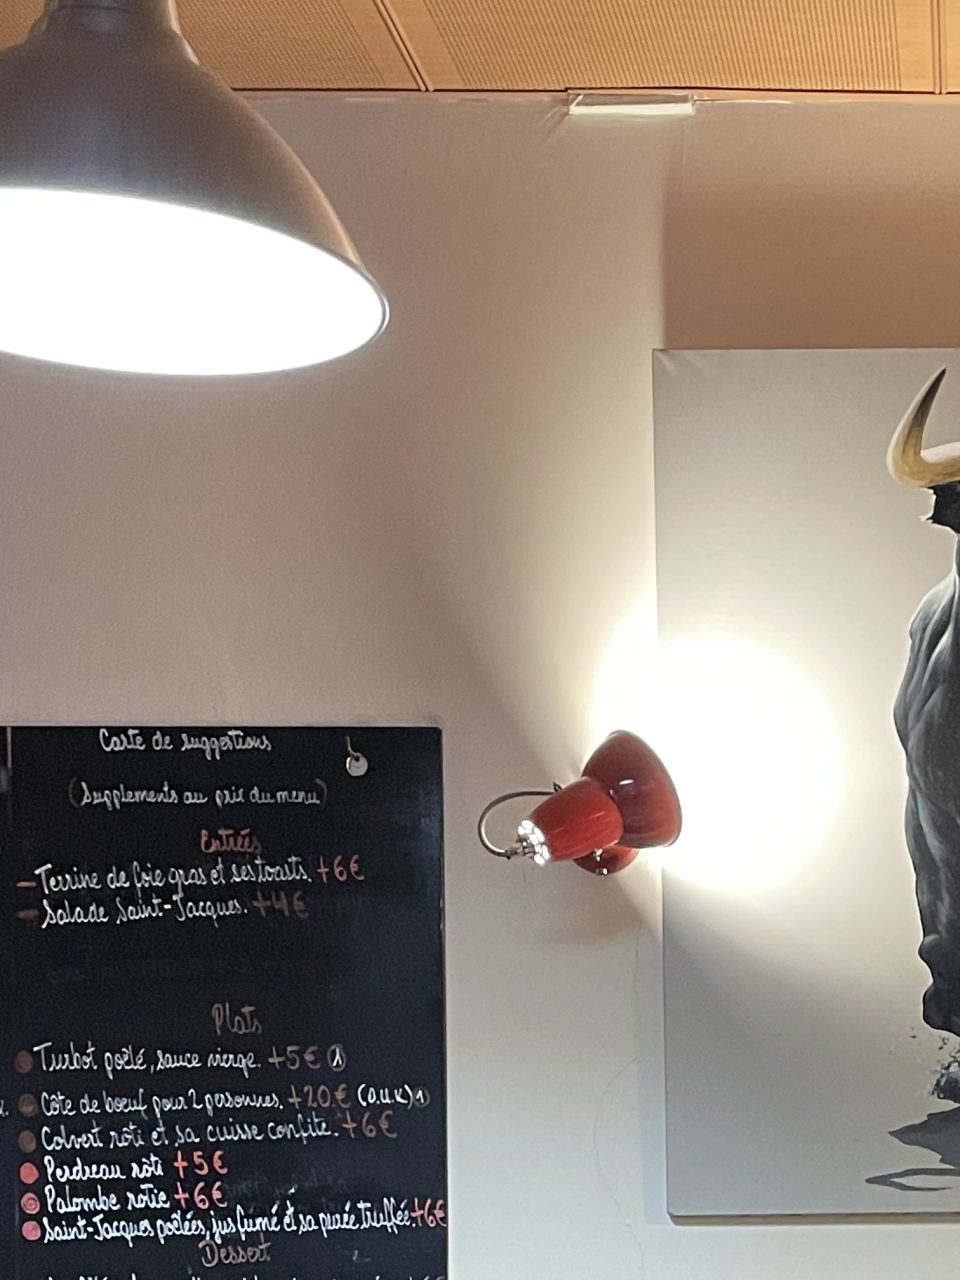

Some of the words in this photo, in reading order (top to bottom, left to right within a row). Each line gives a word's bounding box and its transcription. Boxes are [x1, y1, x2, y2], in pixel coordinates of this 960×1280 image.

[99, 728, 146, 751] Carte
[152, 731, 173, 750] de
[181, 729, 272, 760] suggestions
[183, 789, 208, 804] au
[250, 786, 275, 804] du
[34, 863, 101, 894] Terrine
[107, 865, 129, 888] de
[134, 861, 166, 899] foie
[168, 867, 207, 895] gras
[211, 857, 225, 885] et
[41, 899, 109, 929] Salade
[212, 1003, 262, 1035] Plats
[33, 1041, 97, 1071] Turbot
[157, 1049, 201, 1071] sauce
[41, 1091, 76, 1116] Côte
[80, 1093, 101, 1114] de
[152, 1094, 187, 1121] pour
[188, 1088, 203, 1109] 2
[41, 1120, 103, 1150] Colvert
[151, 1119, 168, 1146] et
[175, 1124, 200, 1147] sa
[207, 1118, 264, 1142] cuisse
[44, 1155, 126, 1183] Perdreau
[44, 1184, 121, 1213] Palombe
[210, 1210, 236, 1245] jus
[236, 1202, 280, 1241] fumé
[283, 1200, 297, 1232] et
[298, 1212, 318, 1235] sa
